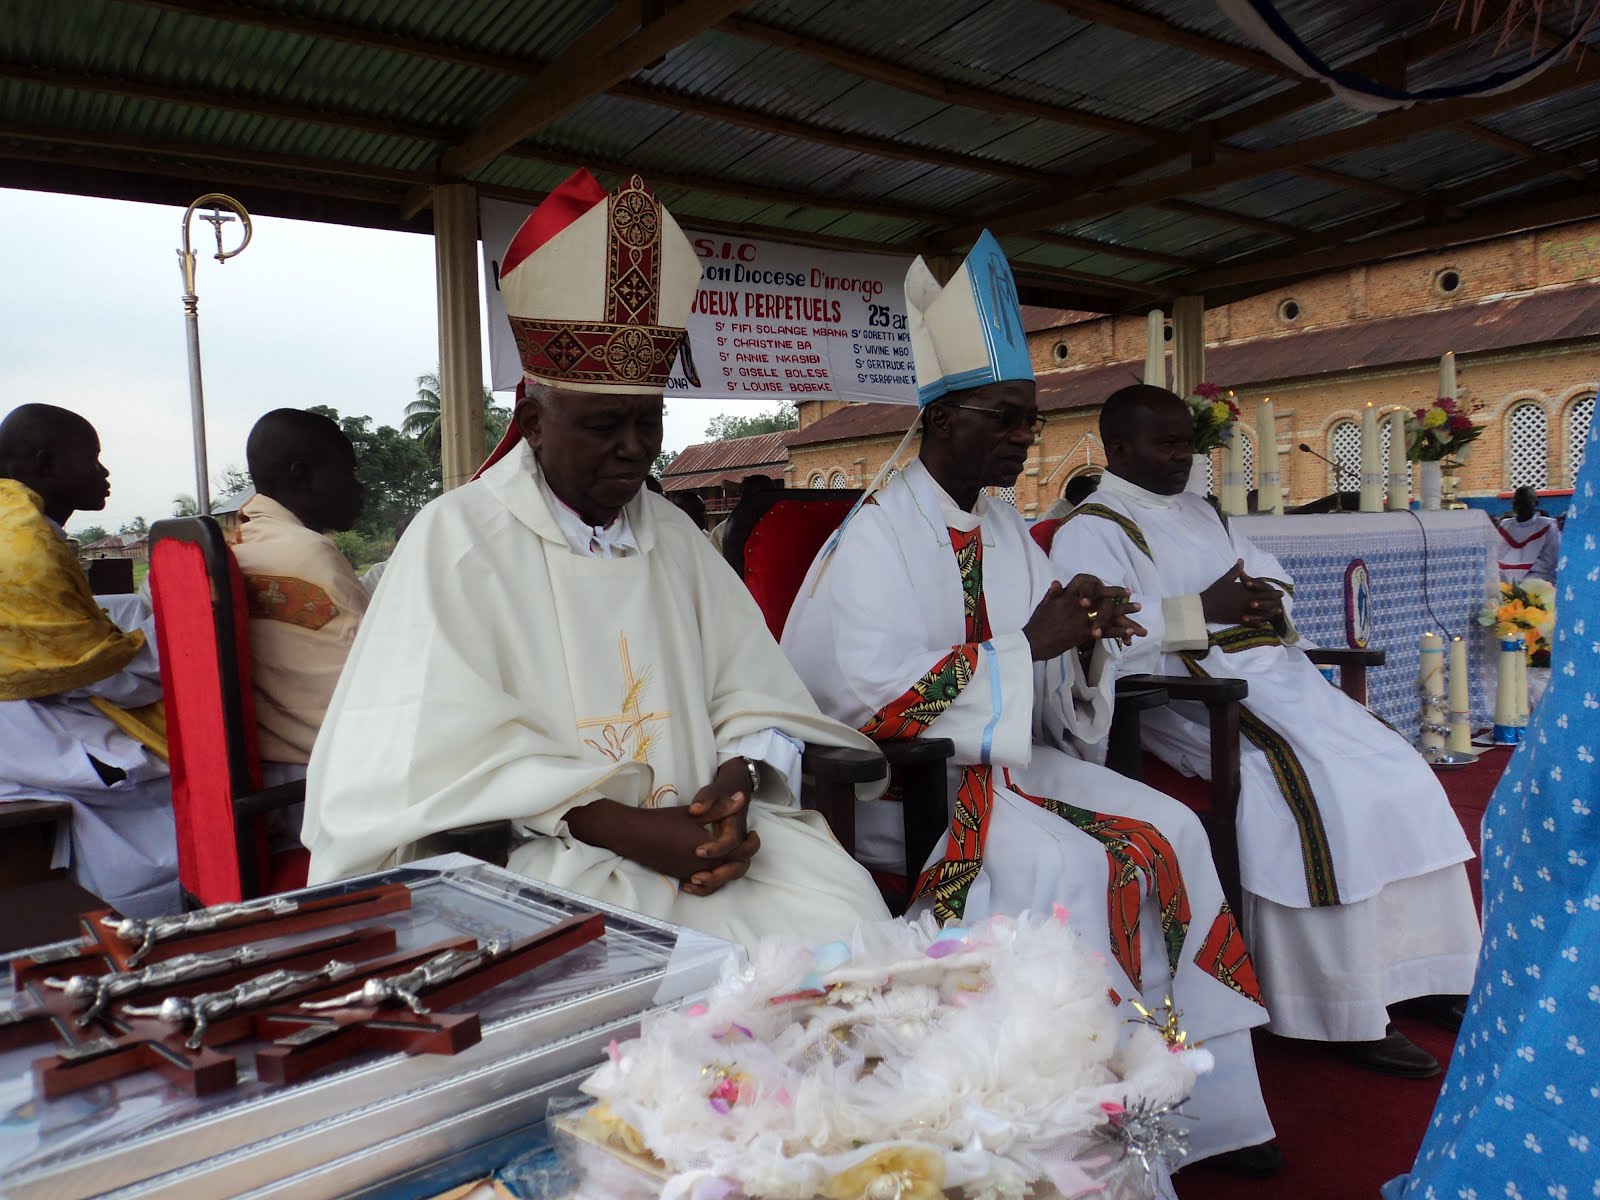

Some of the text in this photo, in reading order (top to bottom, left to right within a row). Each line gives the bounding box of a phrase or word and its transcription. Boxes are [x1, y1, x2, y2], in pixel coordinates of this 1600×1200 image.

[734, 263, 806, 286] Diocese
[810, 268, 883, 303] D'inongo
[745, 292, 841, 323] PERPETUELS
[868, 304, 891, 327] 25
[732, 323, 752, 333] FIFI
[756, 325, 808, 336] SOLANGE
[813, 327, 848, 338] MBANA
[863, 330, 895, 341] GORETTI
[733, 338, 793, 349] CHRISTINE
[797, 341, 812, 350] BA
[864, 345, 890, 356] WIVINE
[893, 346, 909, 357] MBO
[736, 353, 769, 363] ANNIE
[776, 354, 820, 364] NKASIBI
[867, 359, 905, 371] GERTRUDE
[739, 367, 779, 378] GISELE
[785, 368, 829, 378] BOLESE
[869, 374, 910, 385] SERAPHINE
[743, 381, 784, 392] LOUISE
[789, 382, 832, 392] BOBEKE
